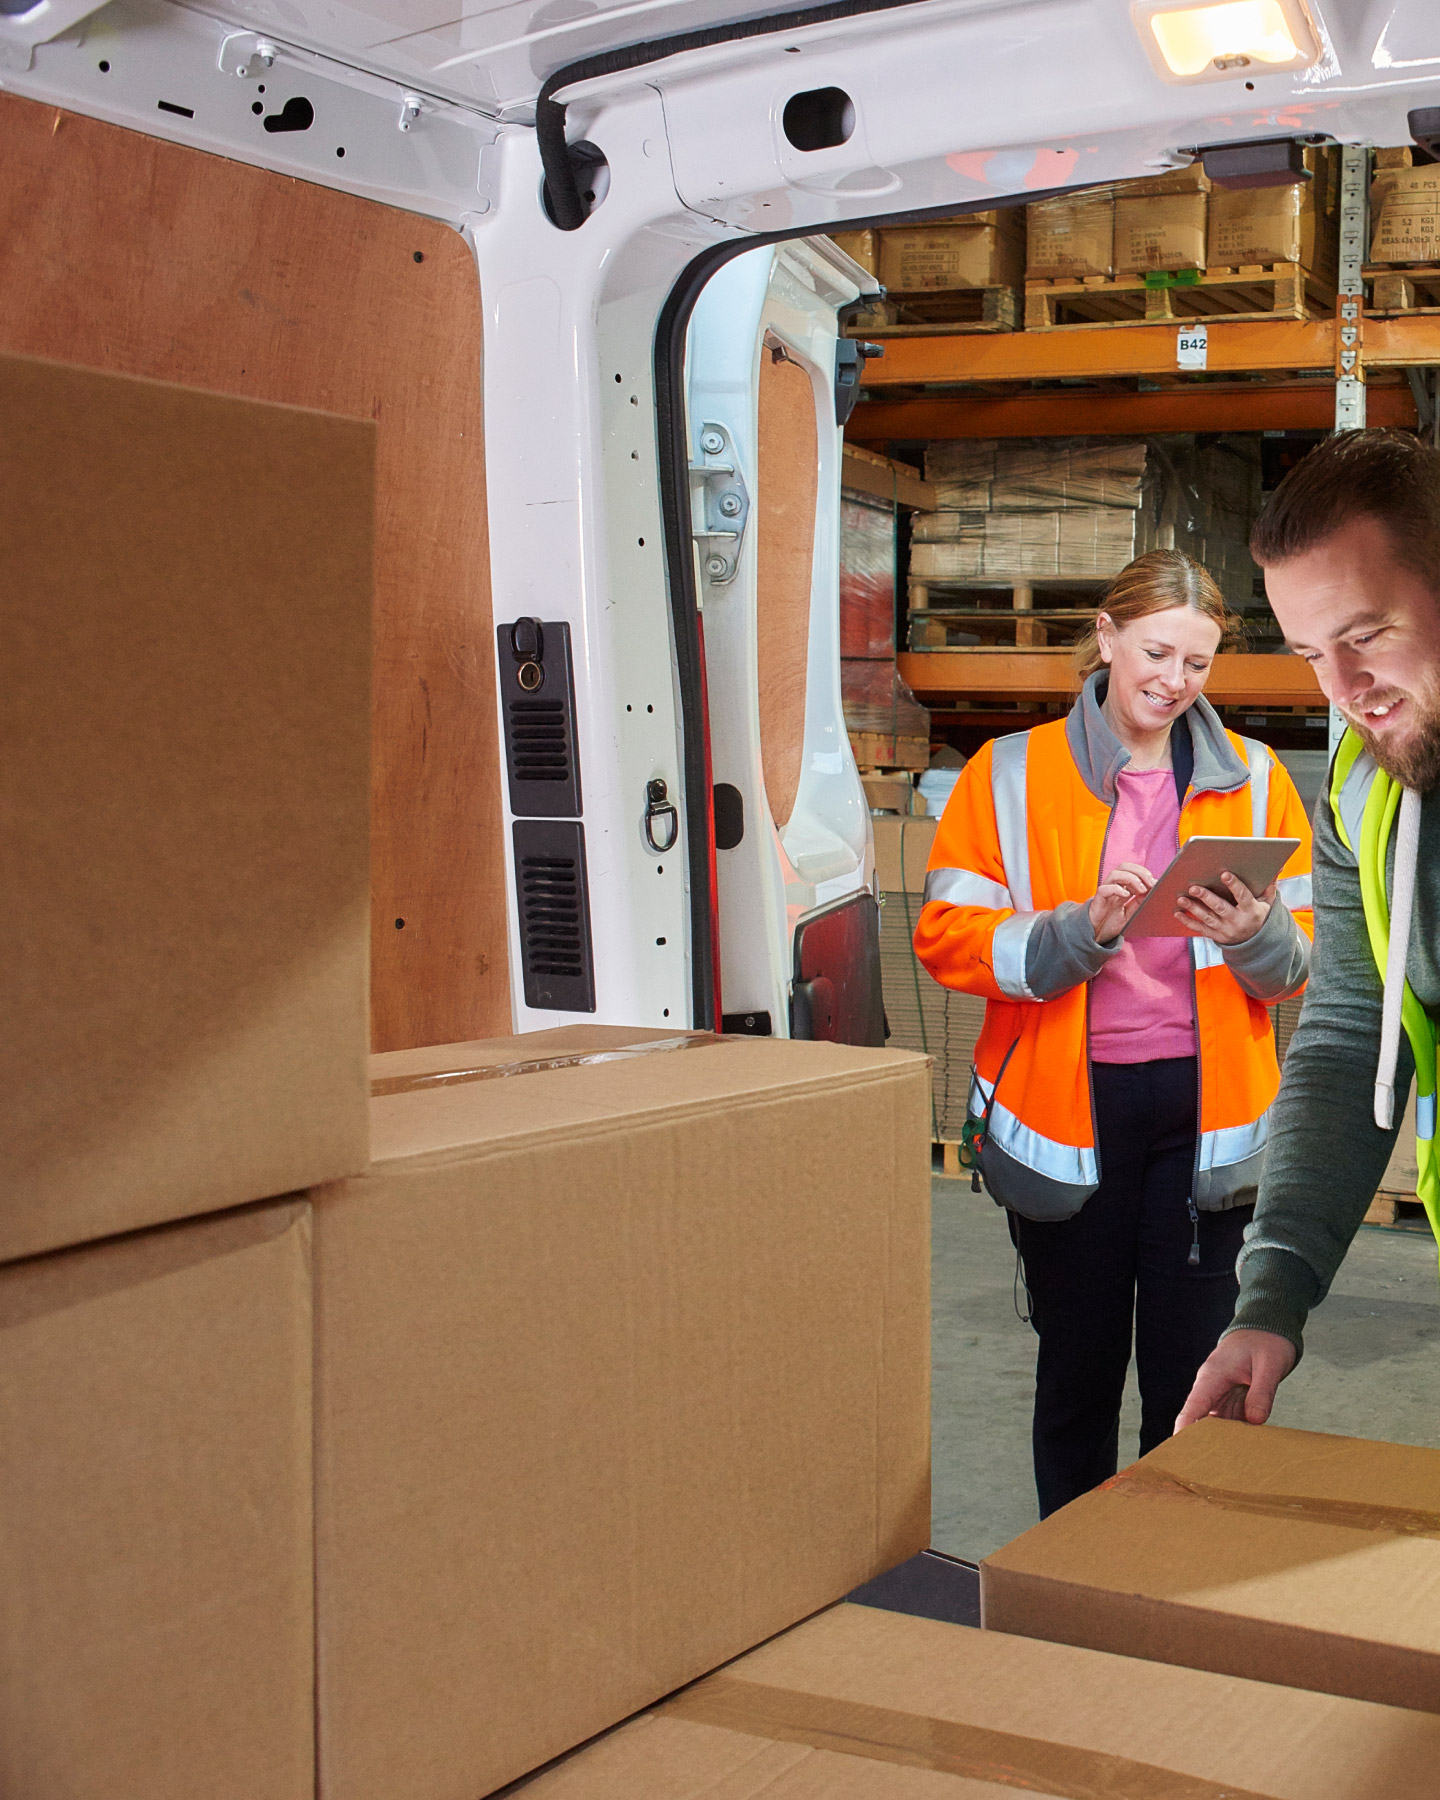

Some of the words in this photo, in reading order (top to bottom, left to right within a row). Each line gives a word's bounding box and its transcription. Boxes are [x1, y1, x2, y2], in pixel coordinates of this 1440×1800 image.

[1423, 181, 1437, 189] PCS
[1402, 218, 1412, 226] 5.2
[1180, 338, 1207, 351] B42
